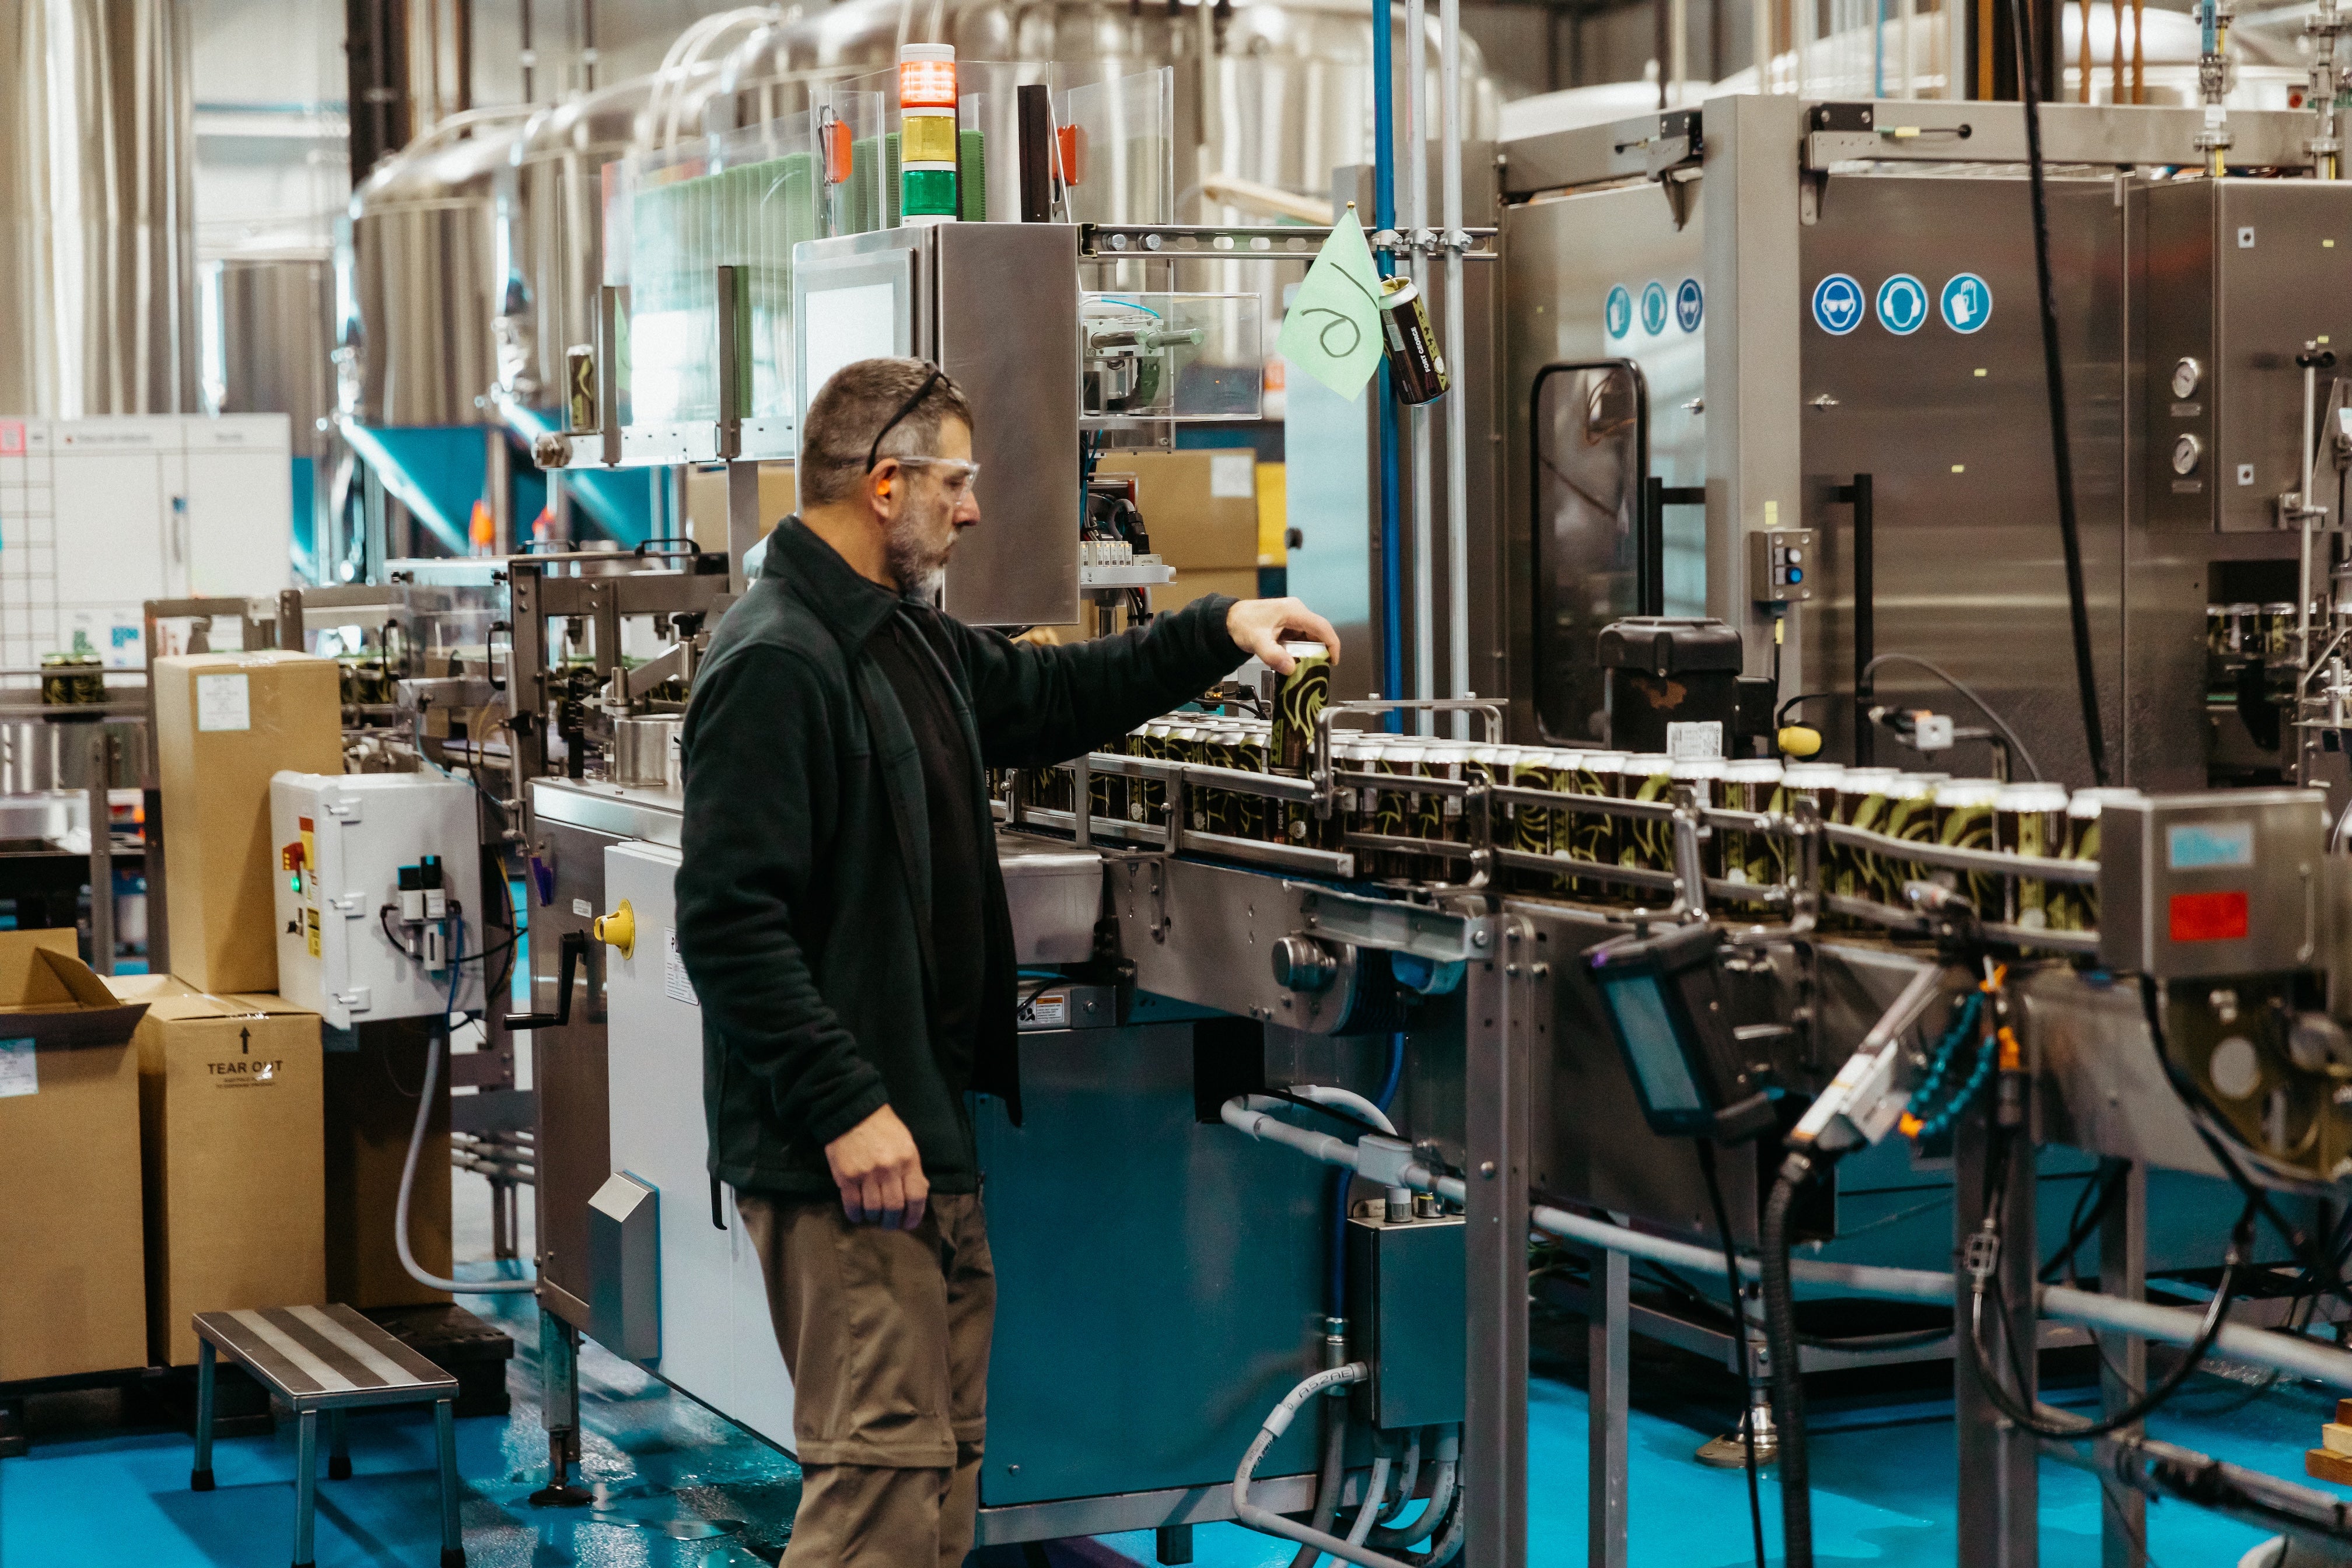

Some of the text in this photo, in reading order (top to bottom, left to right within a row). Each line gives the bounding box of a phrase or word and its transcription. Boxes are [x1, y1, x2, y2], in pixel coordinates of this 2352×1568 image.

[1410, 326, 1424, 354] GEORGE
[1420, 355, 1431, 373] FORT
[208, 1062, 247, 1074] TEAR
